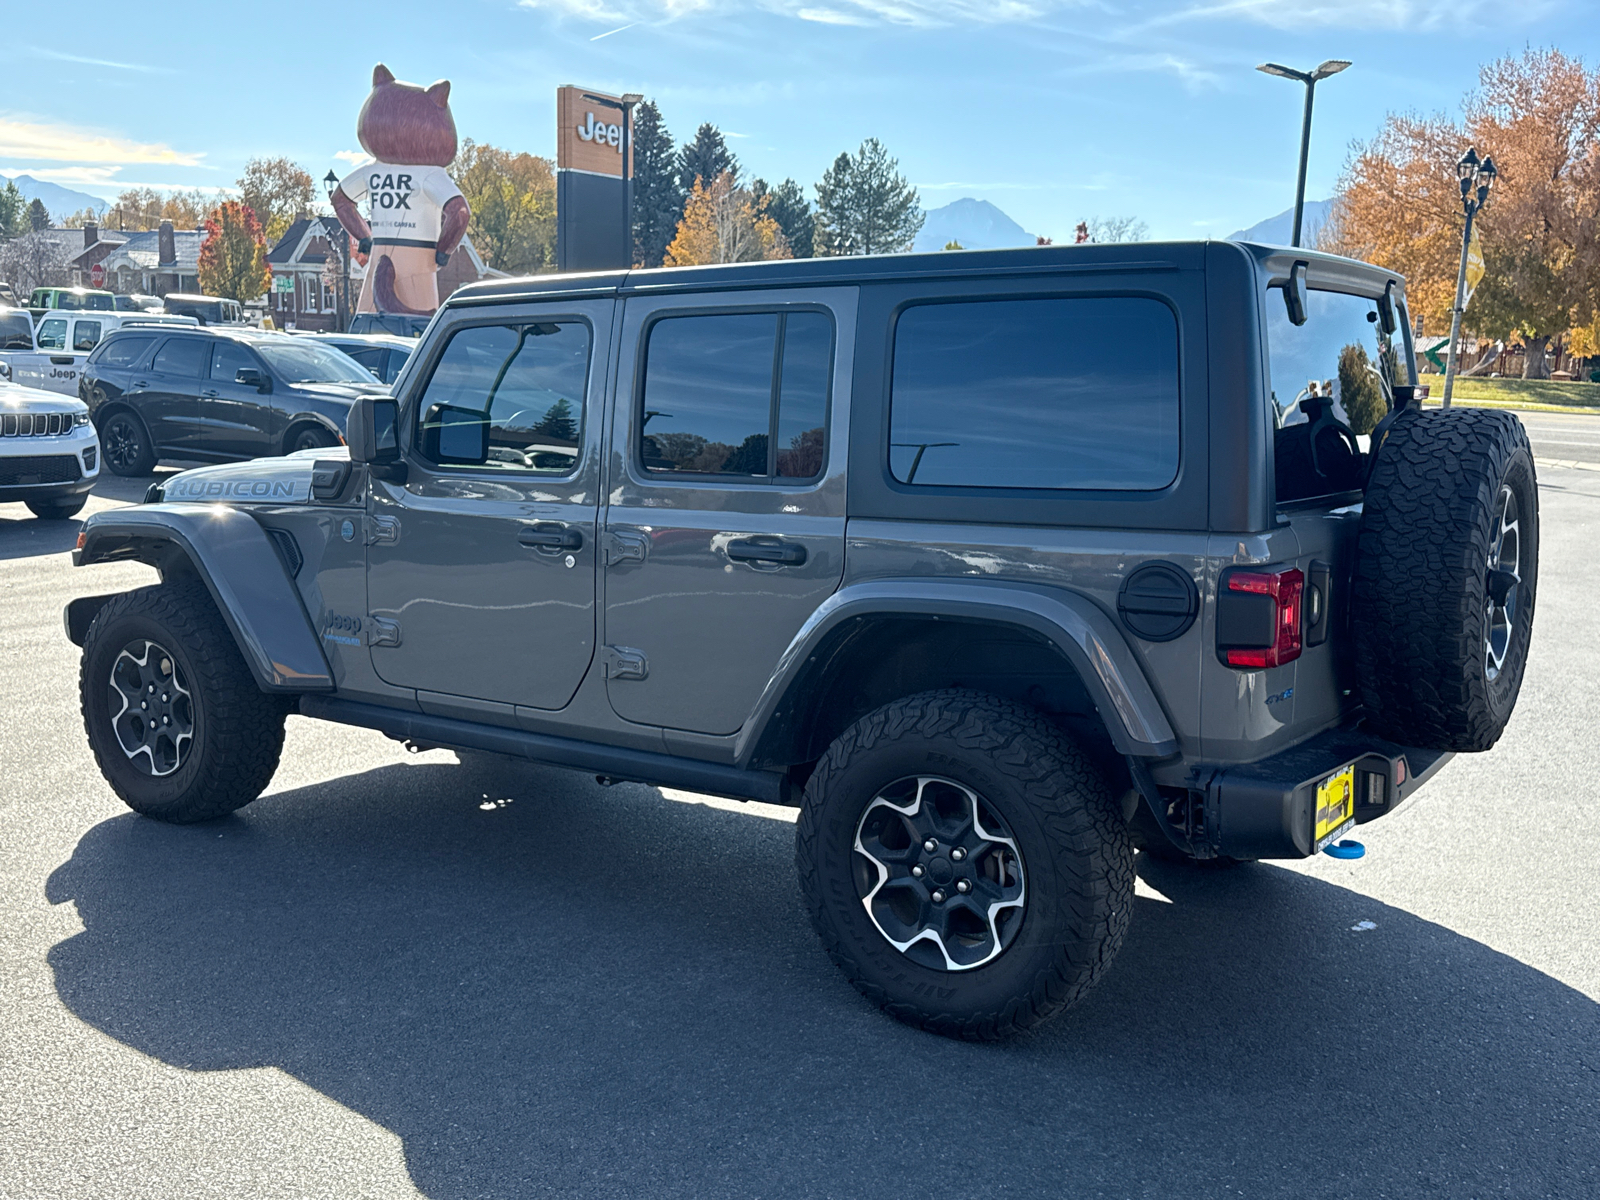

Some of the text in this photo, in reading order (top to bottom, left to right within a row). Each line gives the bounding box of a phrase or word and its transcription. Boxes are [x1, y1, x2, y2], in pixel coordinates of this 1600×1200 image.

[577, 112, 632, 154] Jeep
[369, 173, 413, 190] CAR
[371, 192, 412, 210] FOX
[91, 271, 104, 282] STOP
[49, 368, 76, 380] Jeep
[169, 480, 296, 497] RUBICON
[325, 608, 362, 636] Jeep
